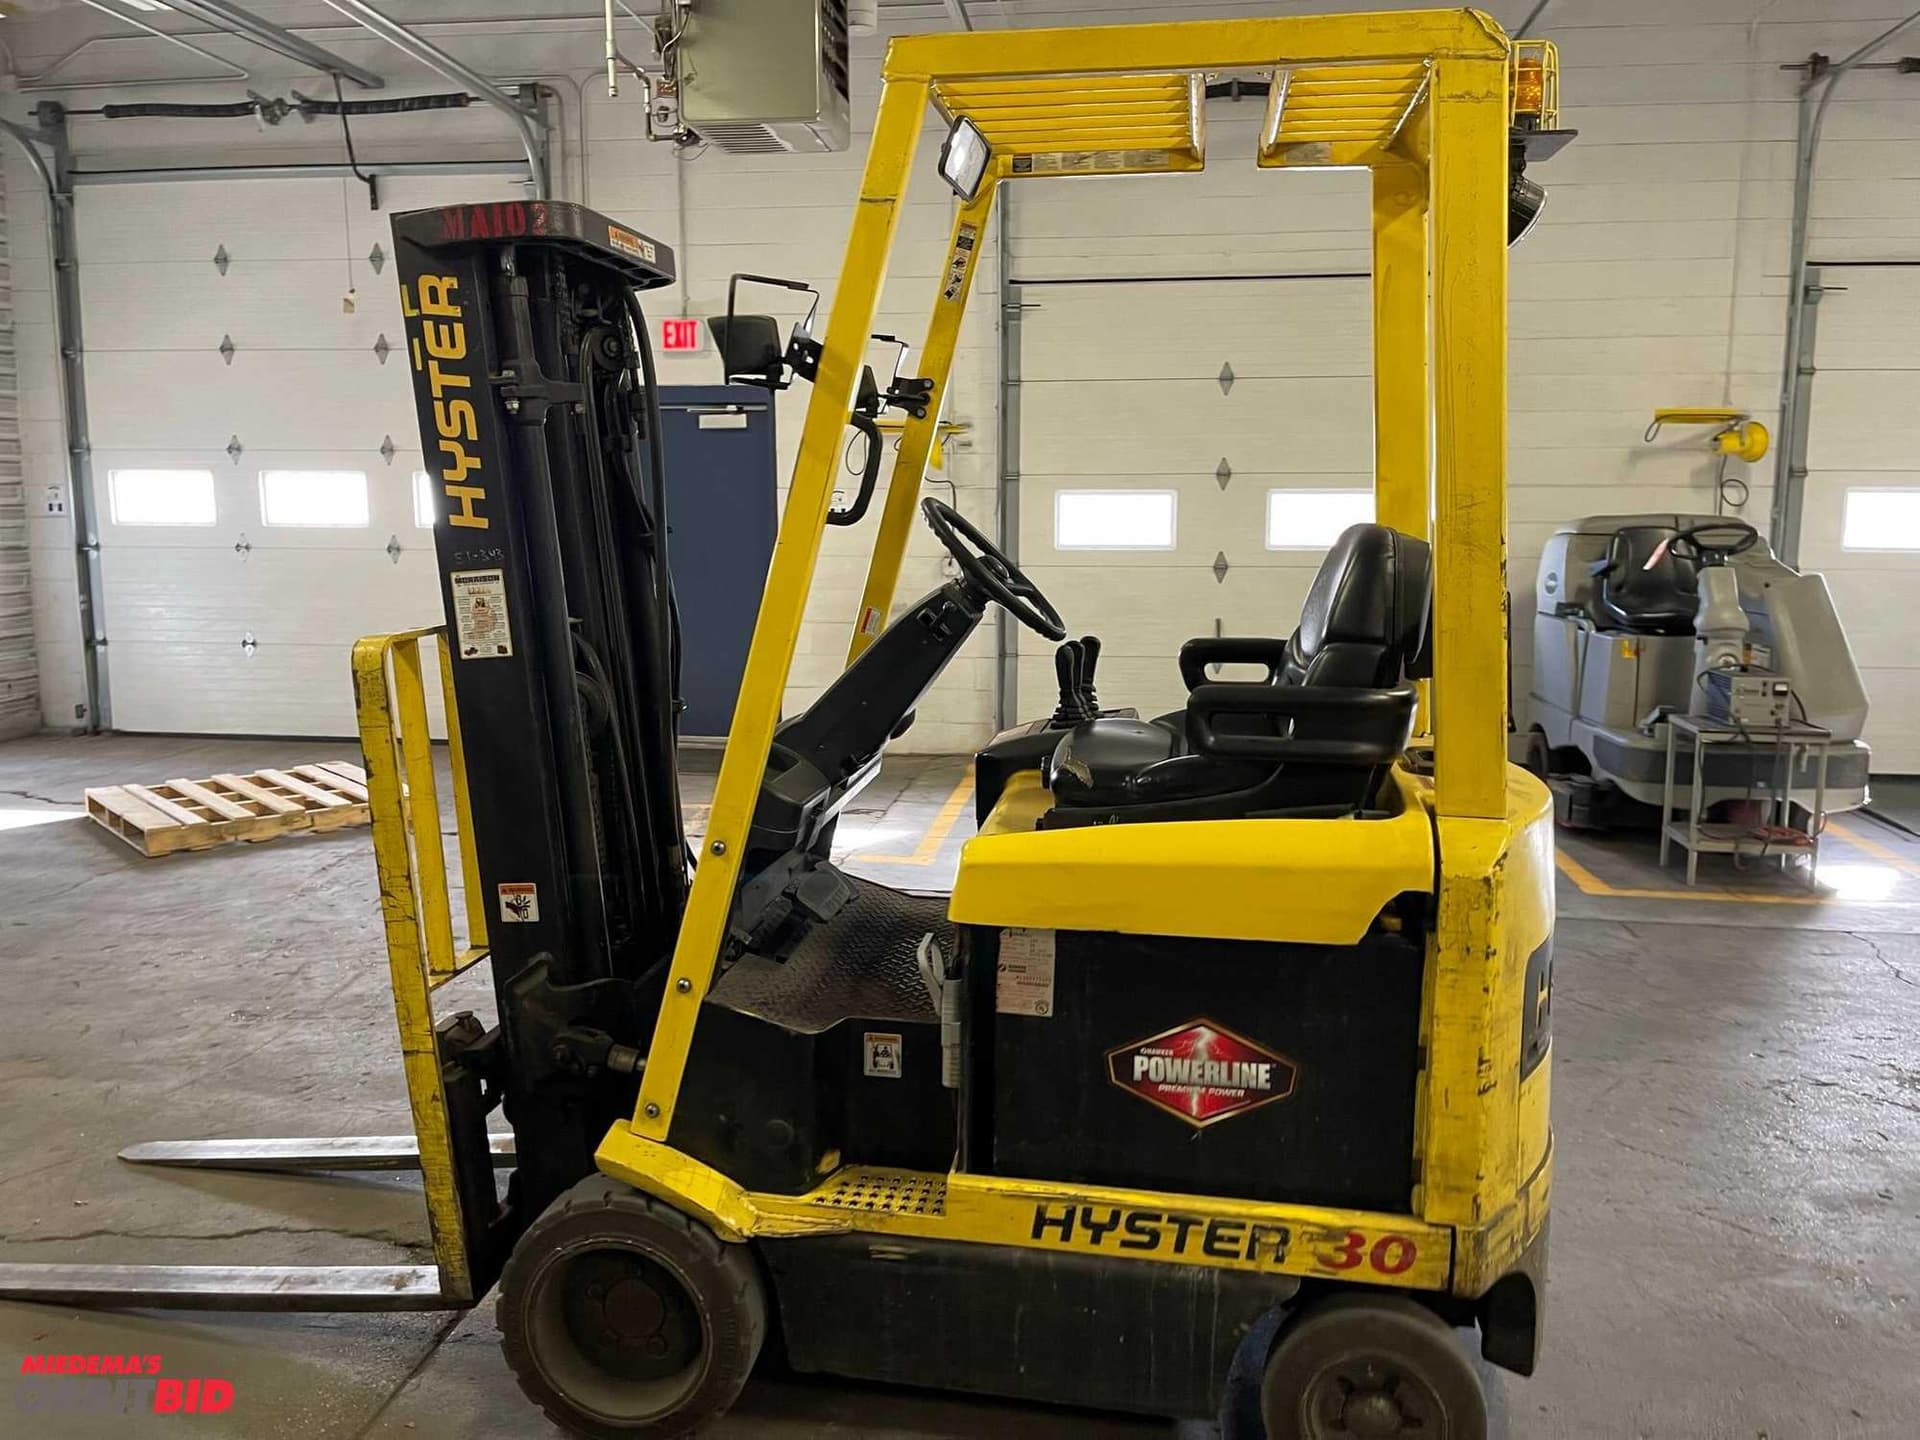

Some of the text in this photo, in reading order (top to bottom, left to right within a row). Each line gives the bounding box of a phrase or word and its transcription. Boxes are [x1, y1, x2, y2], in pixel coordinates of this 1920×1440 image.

[664, 320, 697, 349] EXIT
[417, 274, 490, 530] HYSTER
[1133, 1055, 1272, 1090] POWERLINE
[1208, 1088, 1246, 1098] POWER
[1030, 1205, 1419, 1275] HYSTER 30
